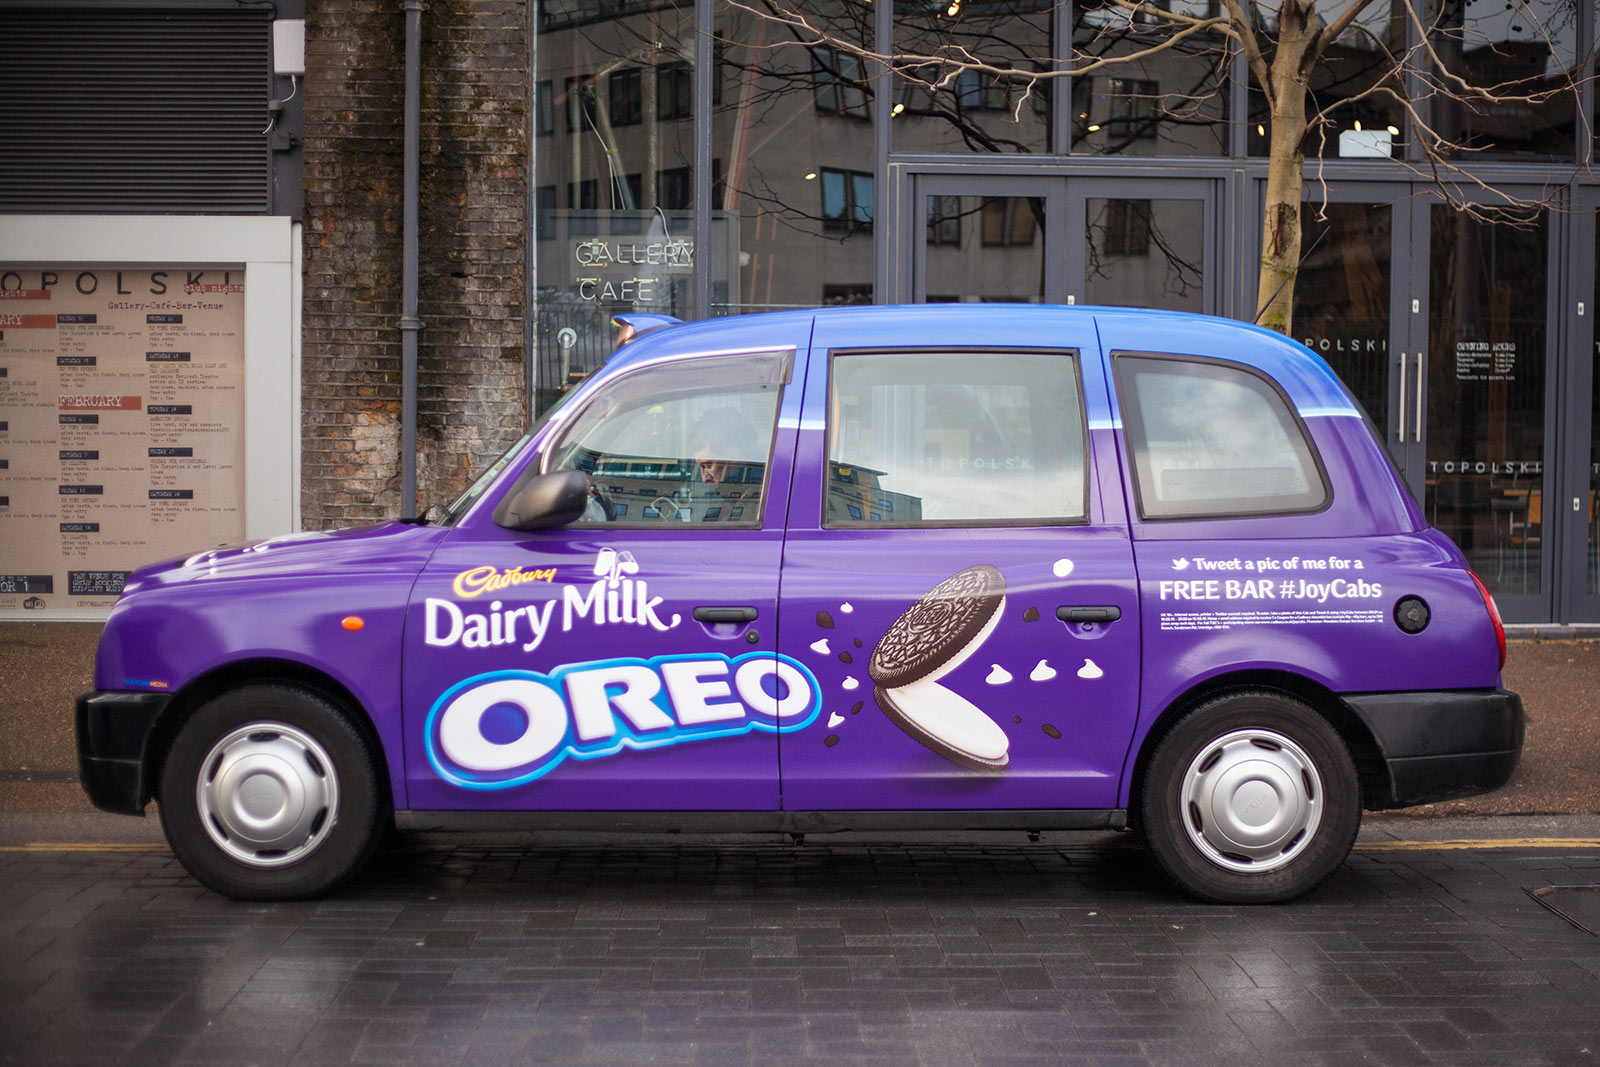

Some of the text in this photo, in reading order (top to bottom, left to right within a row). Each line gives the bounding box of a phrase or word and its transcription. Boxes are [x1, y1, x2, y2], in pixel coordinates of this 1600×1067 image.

[576, 243, 694, 265] GALLERY
[59, 395, 122, 407] FEBRUARY
[1429, 460, 1543, 474] TOPOLSKI
[1192, 556, 1364, 573] Tweet a pic of me for a
[453, 565, 558, 598] Cadbury
[1159, 578, 1383, 603] FREE BAR #JoyCabs
[424, 576, 682, 652] Dairy Milk
[439, 658, 812, 772] OREO
